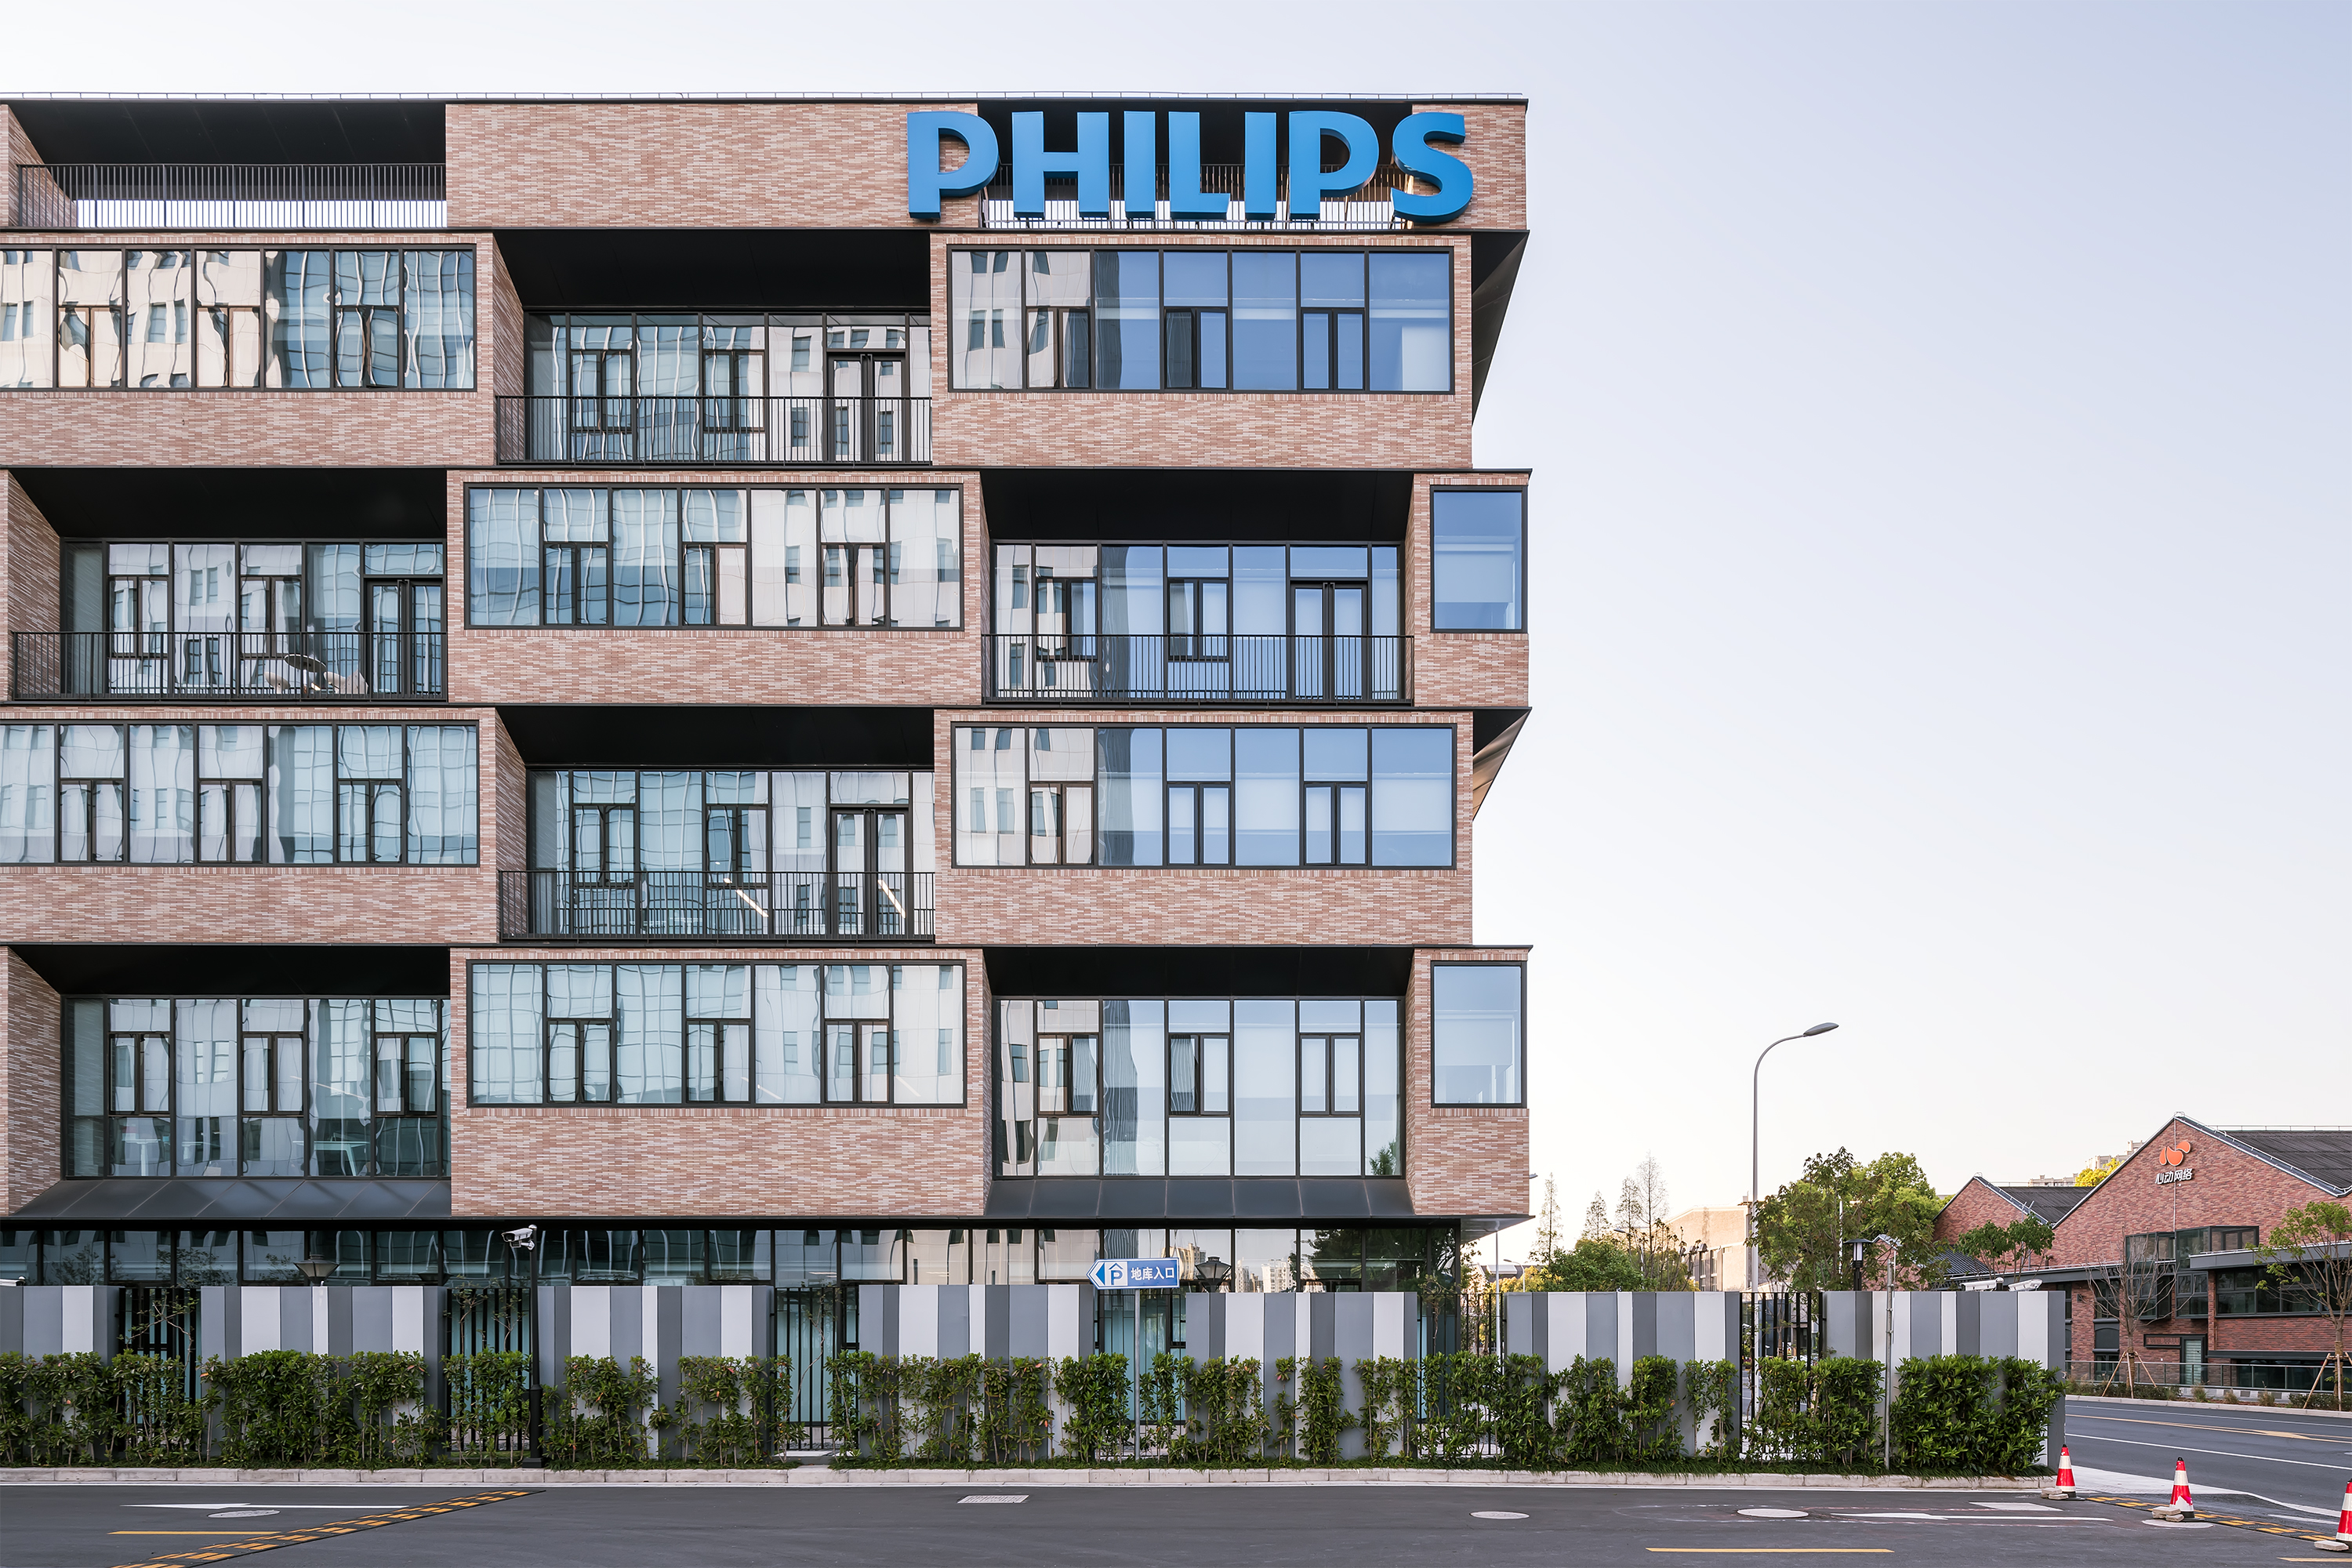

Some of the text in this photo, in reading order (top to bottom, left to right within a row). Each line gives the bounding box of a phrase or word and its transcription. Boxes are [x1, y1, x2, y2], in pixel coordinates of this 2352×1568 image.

[906, 111, 1474, 223] PHILIPS
[2154, 1168, 2193, 1185] 心动网络
[1111, 1270, 1123, 1286] P
[1131, 1267, 1175, 1281] 地库入口
